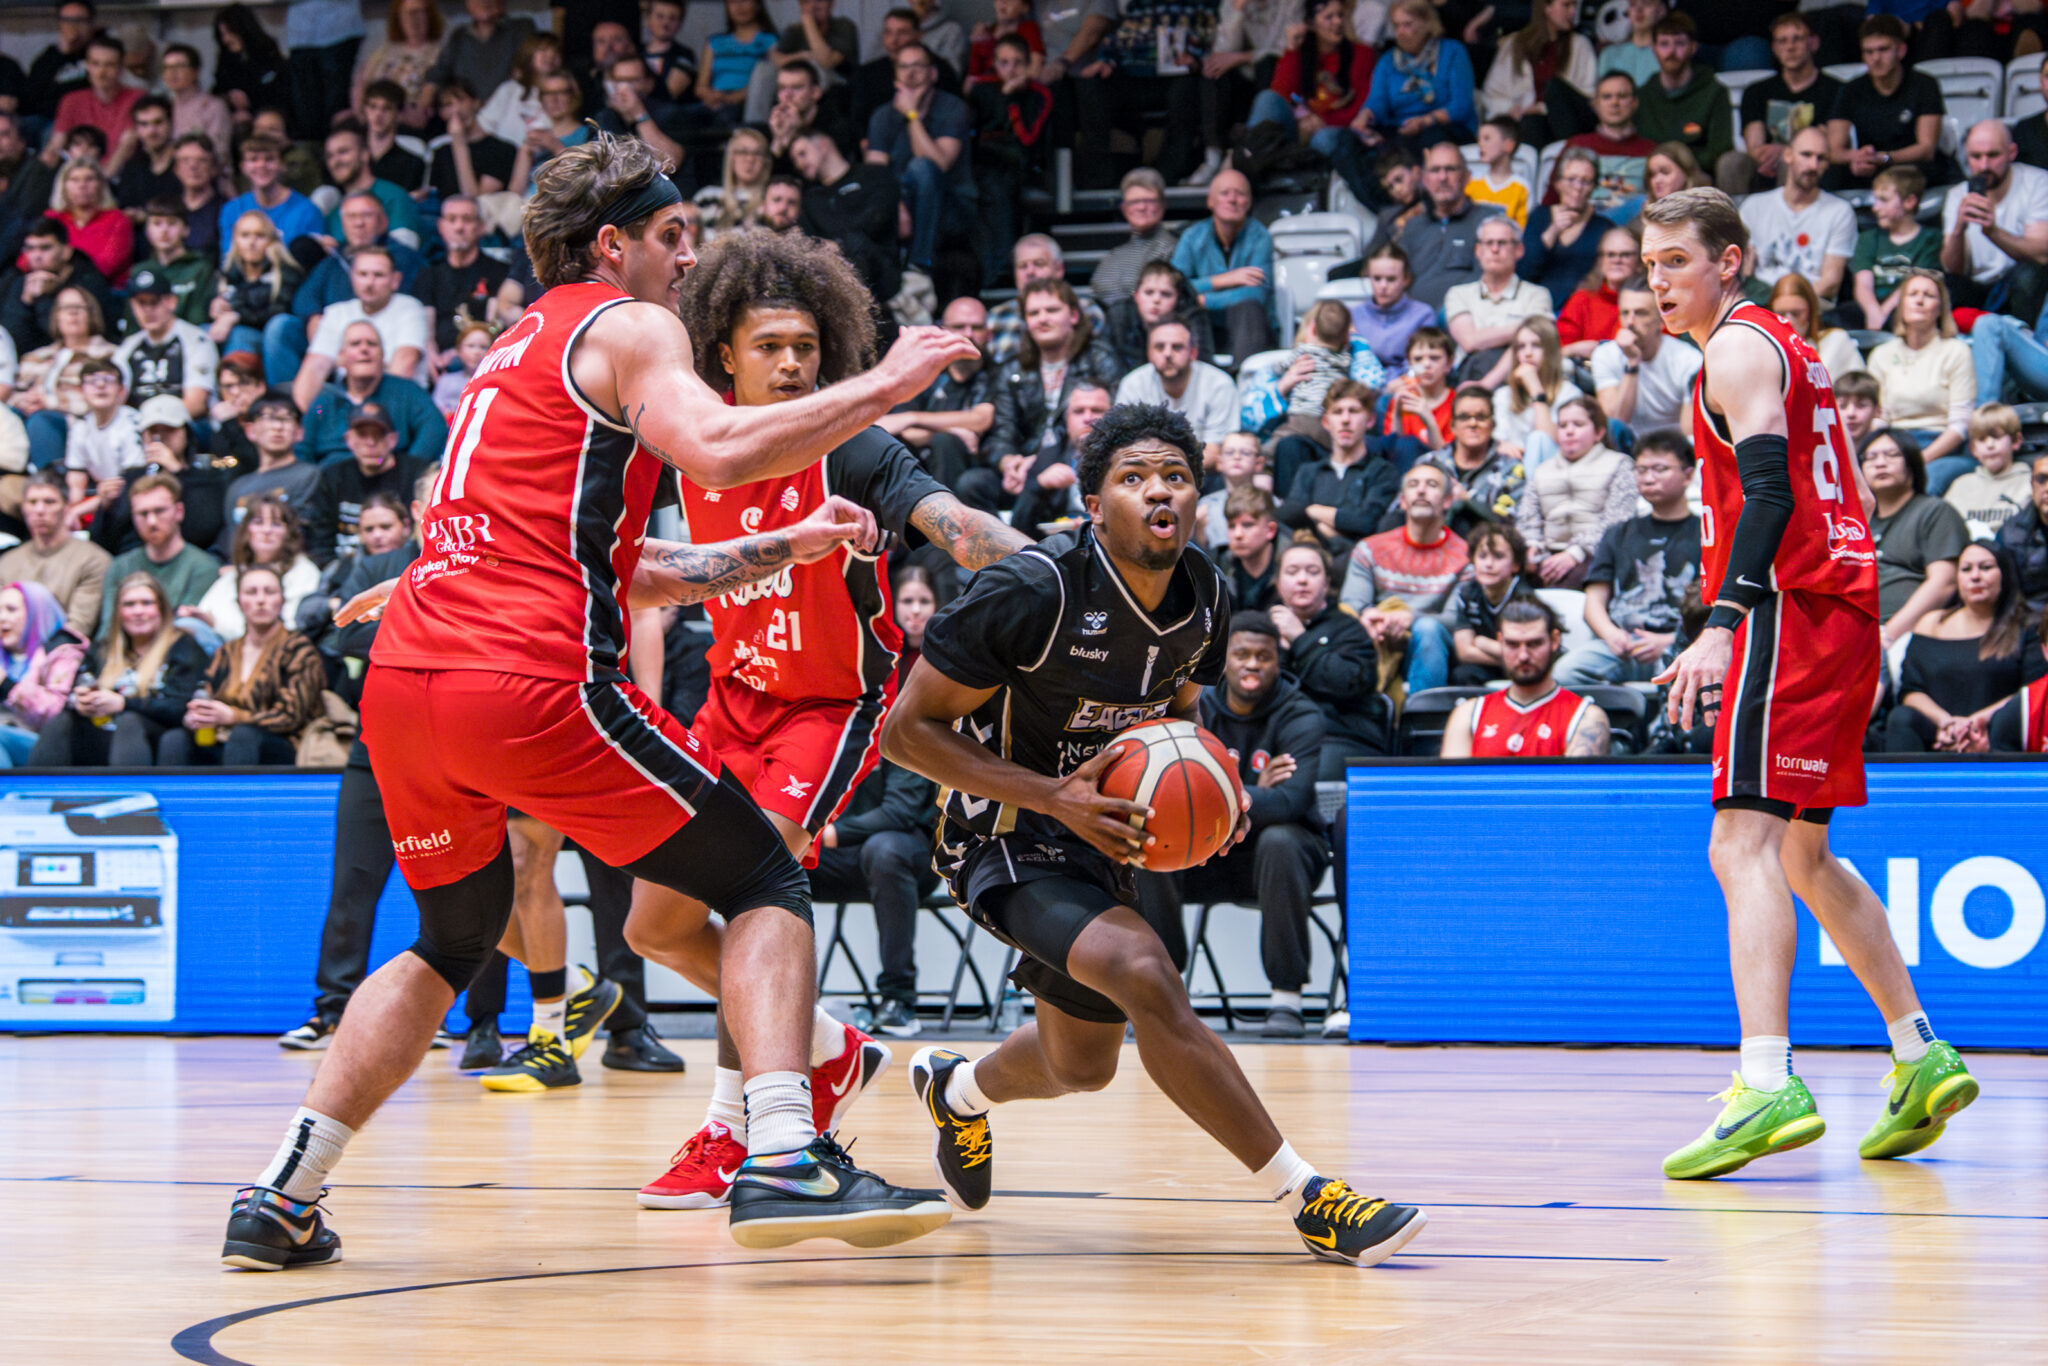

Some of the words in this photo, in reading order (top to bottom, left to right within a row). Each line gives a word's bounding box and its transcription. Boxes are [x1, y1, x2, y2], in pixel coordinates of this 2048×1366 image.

[431, 387, 499, 508] 11
[449, 553, 479, 566] Play
[766, 607, 802, 652] 21
[1070, 645, 1110, 662] blusky
[1140, 645, 1160, 697] 1
